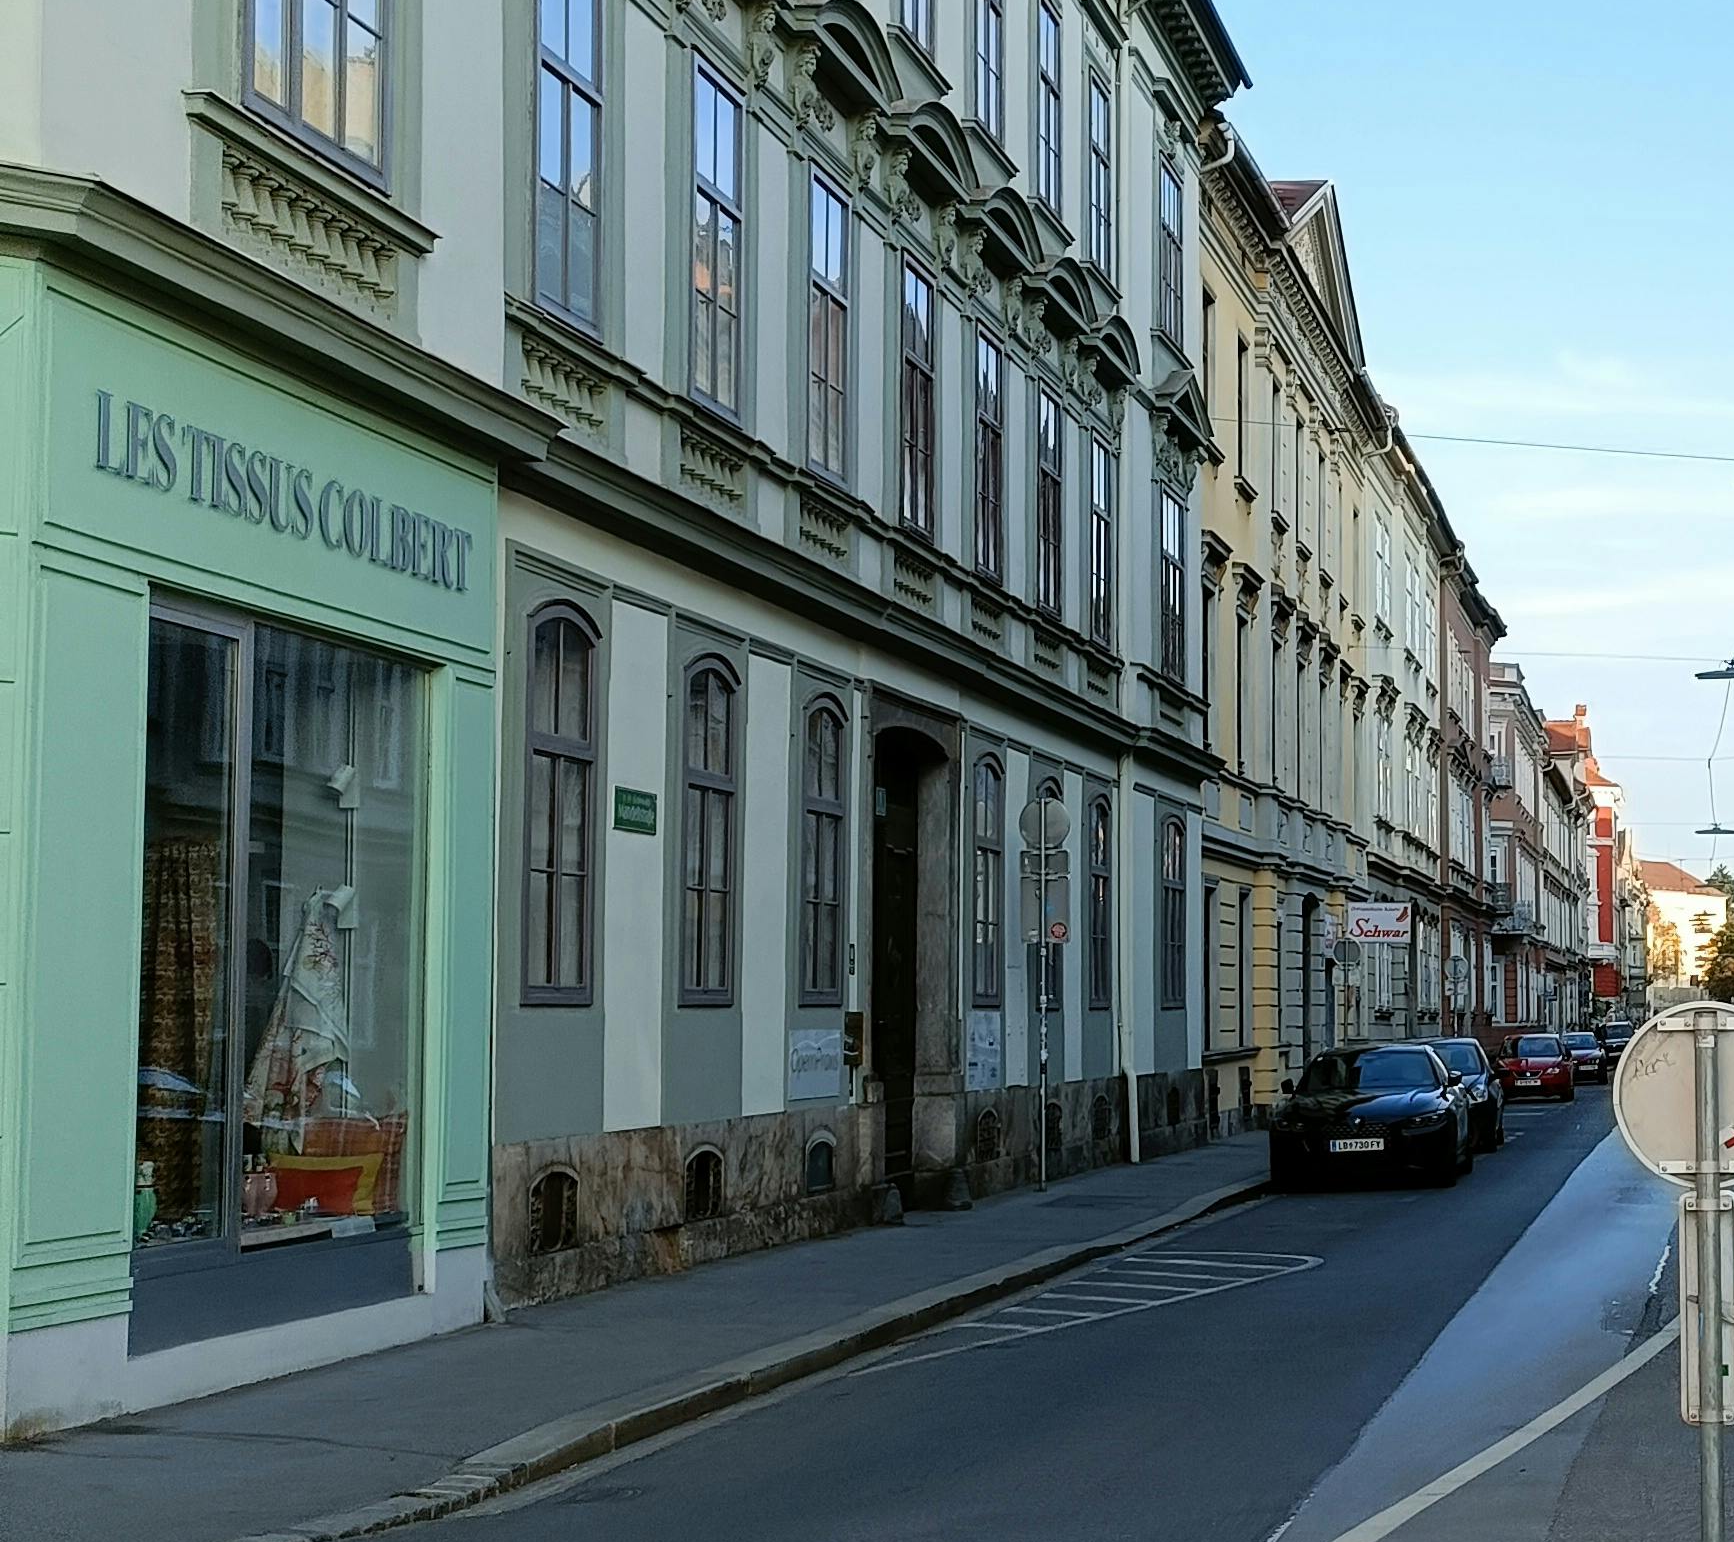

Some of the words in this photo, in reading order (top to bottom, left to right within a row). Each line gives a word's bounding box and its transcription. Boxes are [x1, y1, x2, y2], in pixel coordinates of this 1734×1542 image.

[95, 388, 177, 492] LES
[181, 424, 314, 540] TISSUS
[319, 478, 473, 592] COLBERT
[1349, 917, 1409, 938] Schwar
